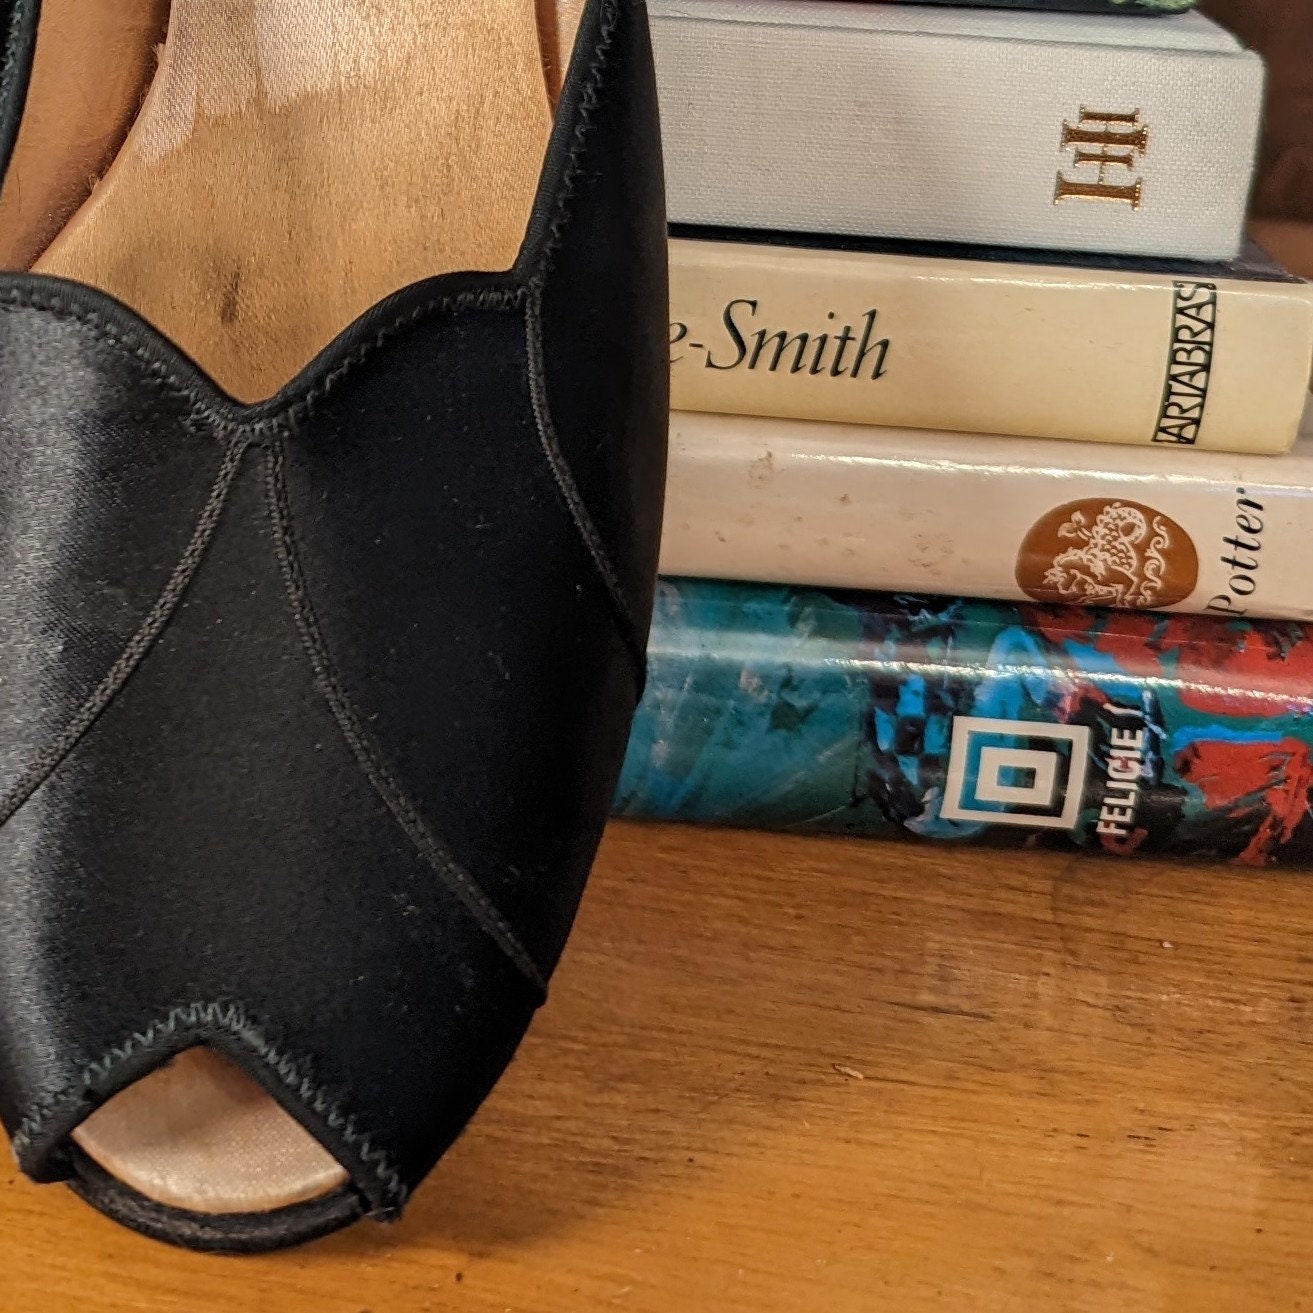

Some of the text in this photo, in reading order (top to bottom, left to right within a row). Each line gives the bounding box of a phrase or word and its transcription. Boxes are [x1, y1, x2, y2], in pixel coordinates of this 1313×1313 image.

[1151, 280, 1217, 445] ARTABRAS
[1203, 487, 1265, 617] Potter
[1096, 727, 1147, 838] FELICIE
